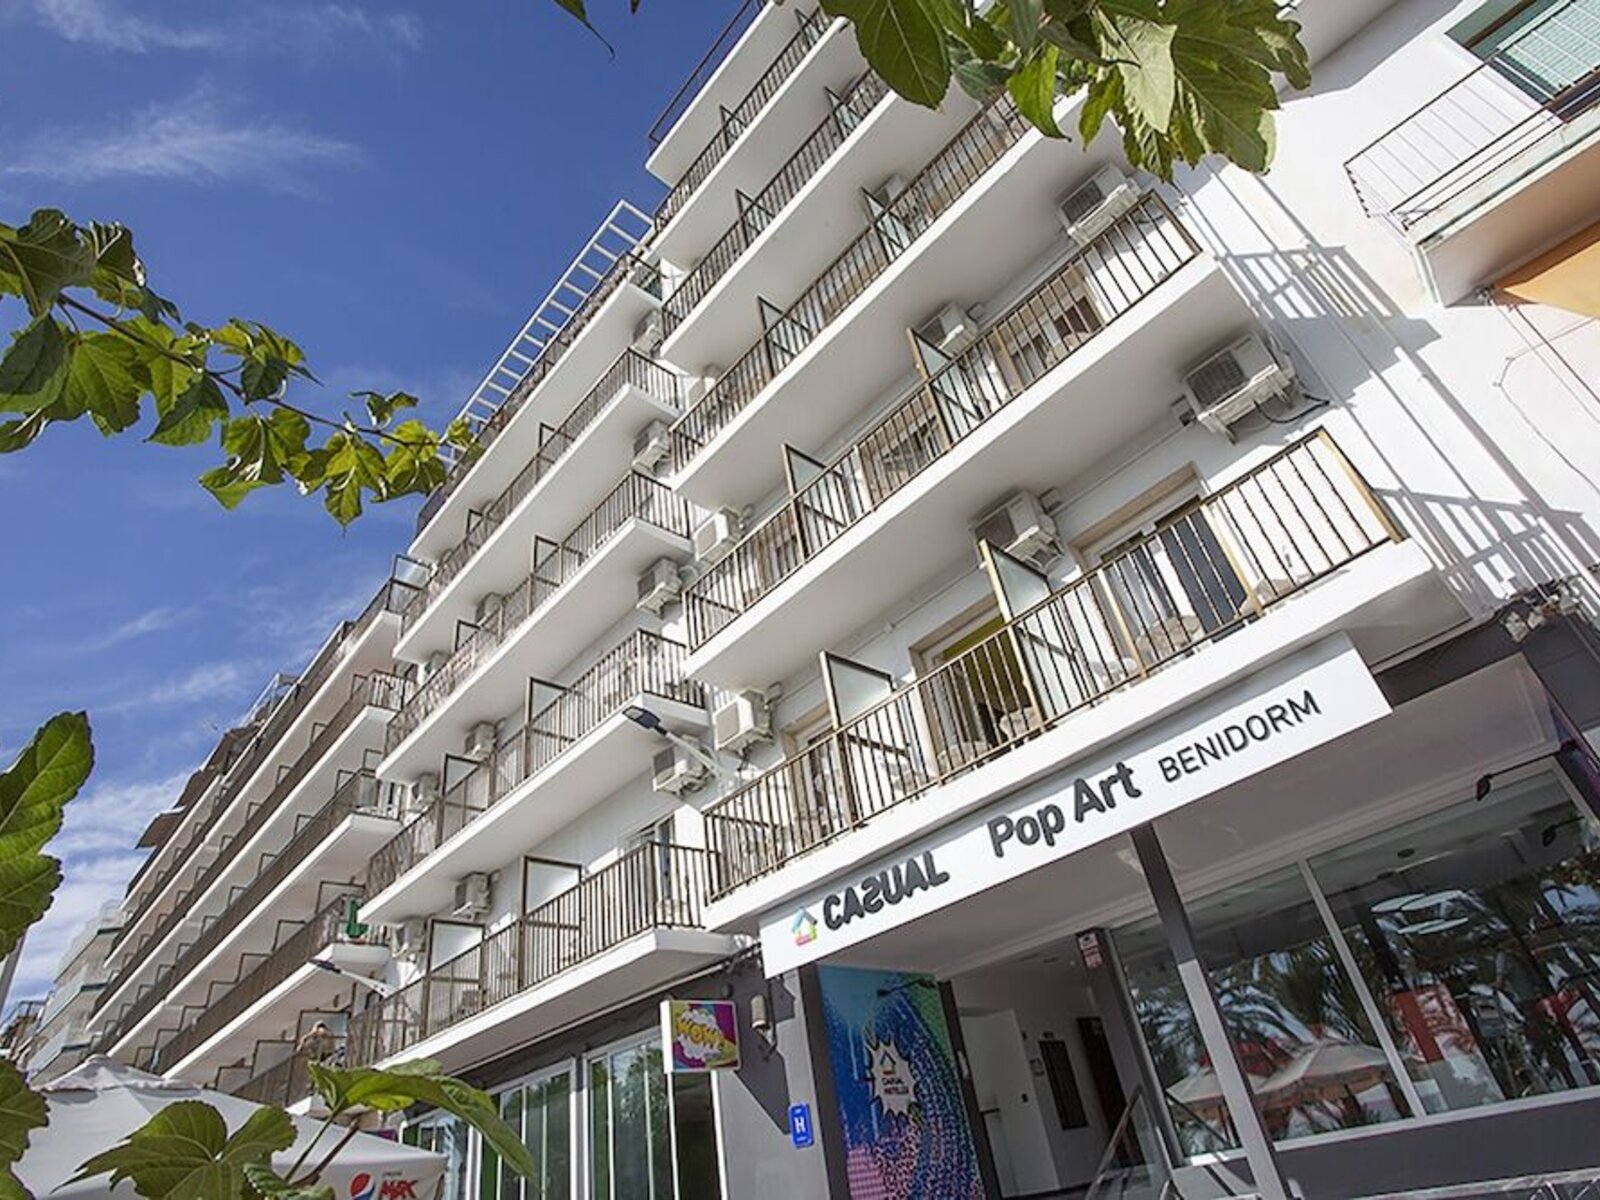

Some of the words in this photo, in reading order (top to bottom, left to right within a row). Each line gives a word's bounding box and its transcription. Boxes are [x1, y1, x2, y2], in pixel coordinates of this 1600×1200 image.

[823, 850, 950, 931] CASUAL
[987, 803, 1066, 858] Pop
[1072, 761, 1143, 823] Art
[1157, 690, 1323, 784] BENIDORM
[794, 1116, 807, 1134] H
